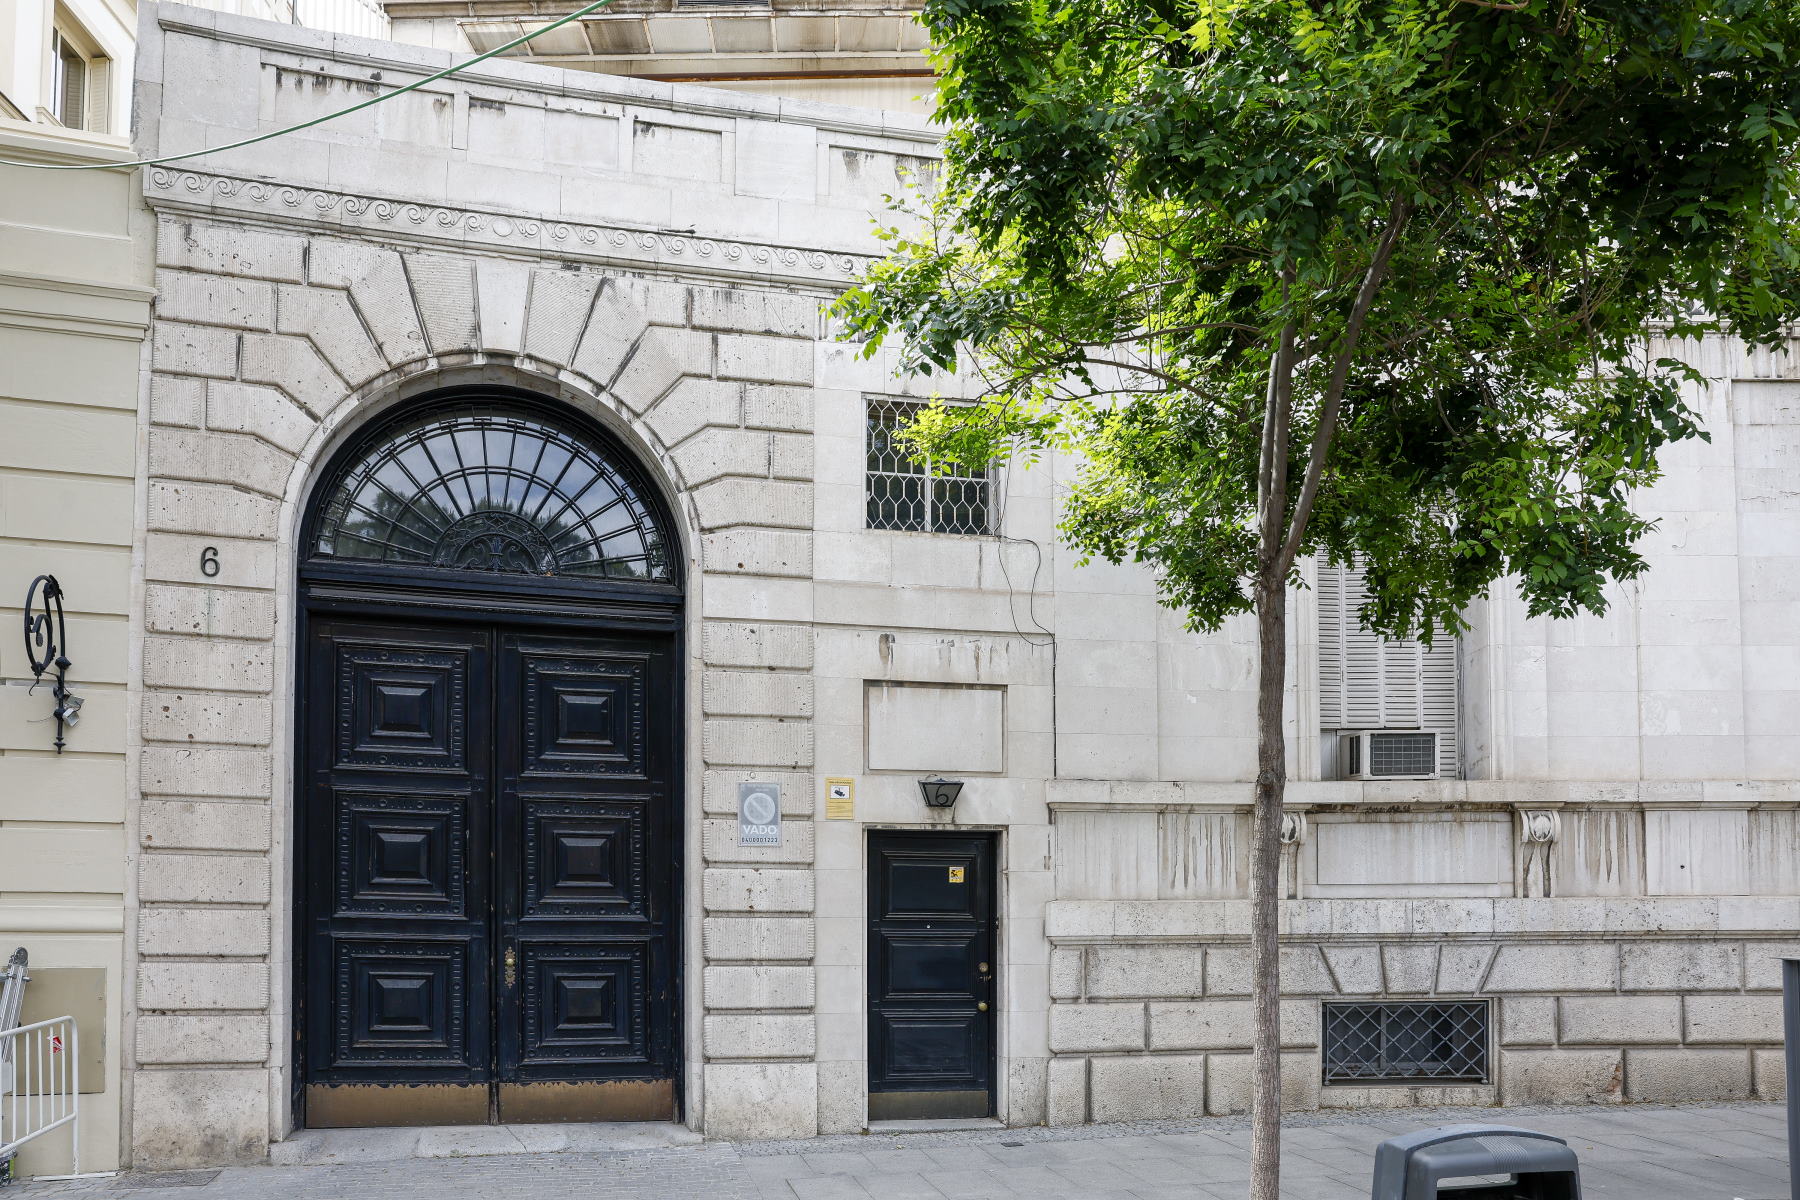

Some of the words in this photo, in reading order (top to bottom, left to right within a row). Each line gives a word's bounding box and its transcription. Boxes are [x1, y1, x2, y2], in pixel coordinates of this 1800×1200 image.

[201, 546, 220, 577] 6
[935, 784, 949, 806] 6
[743, 825, 777, 835] VADO
